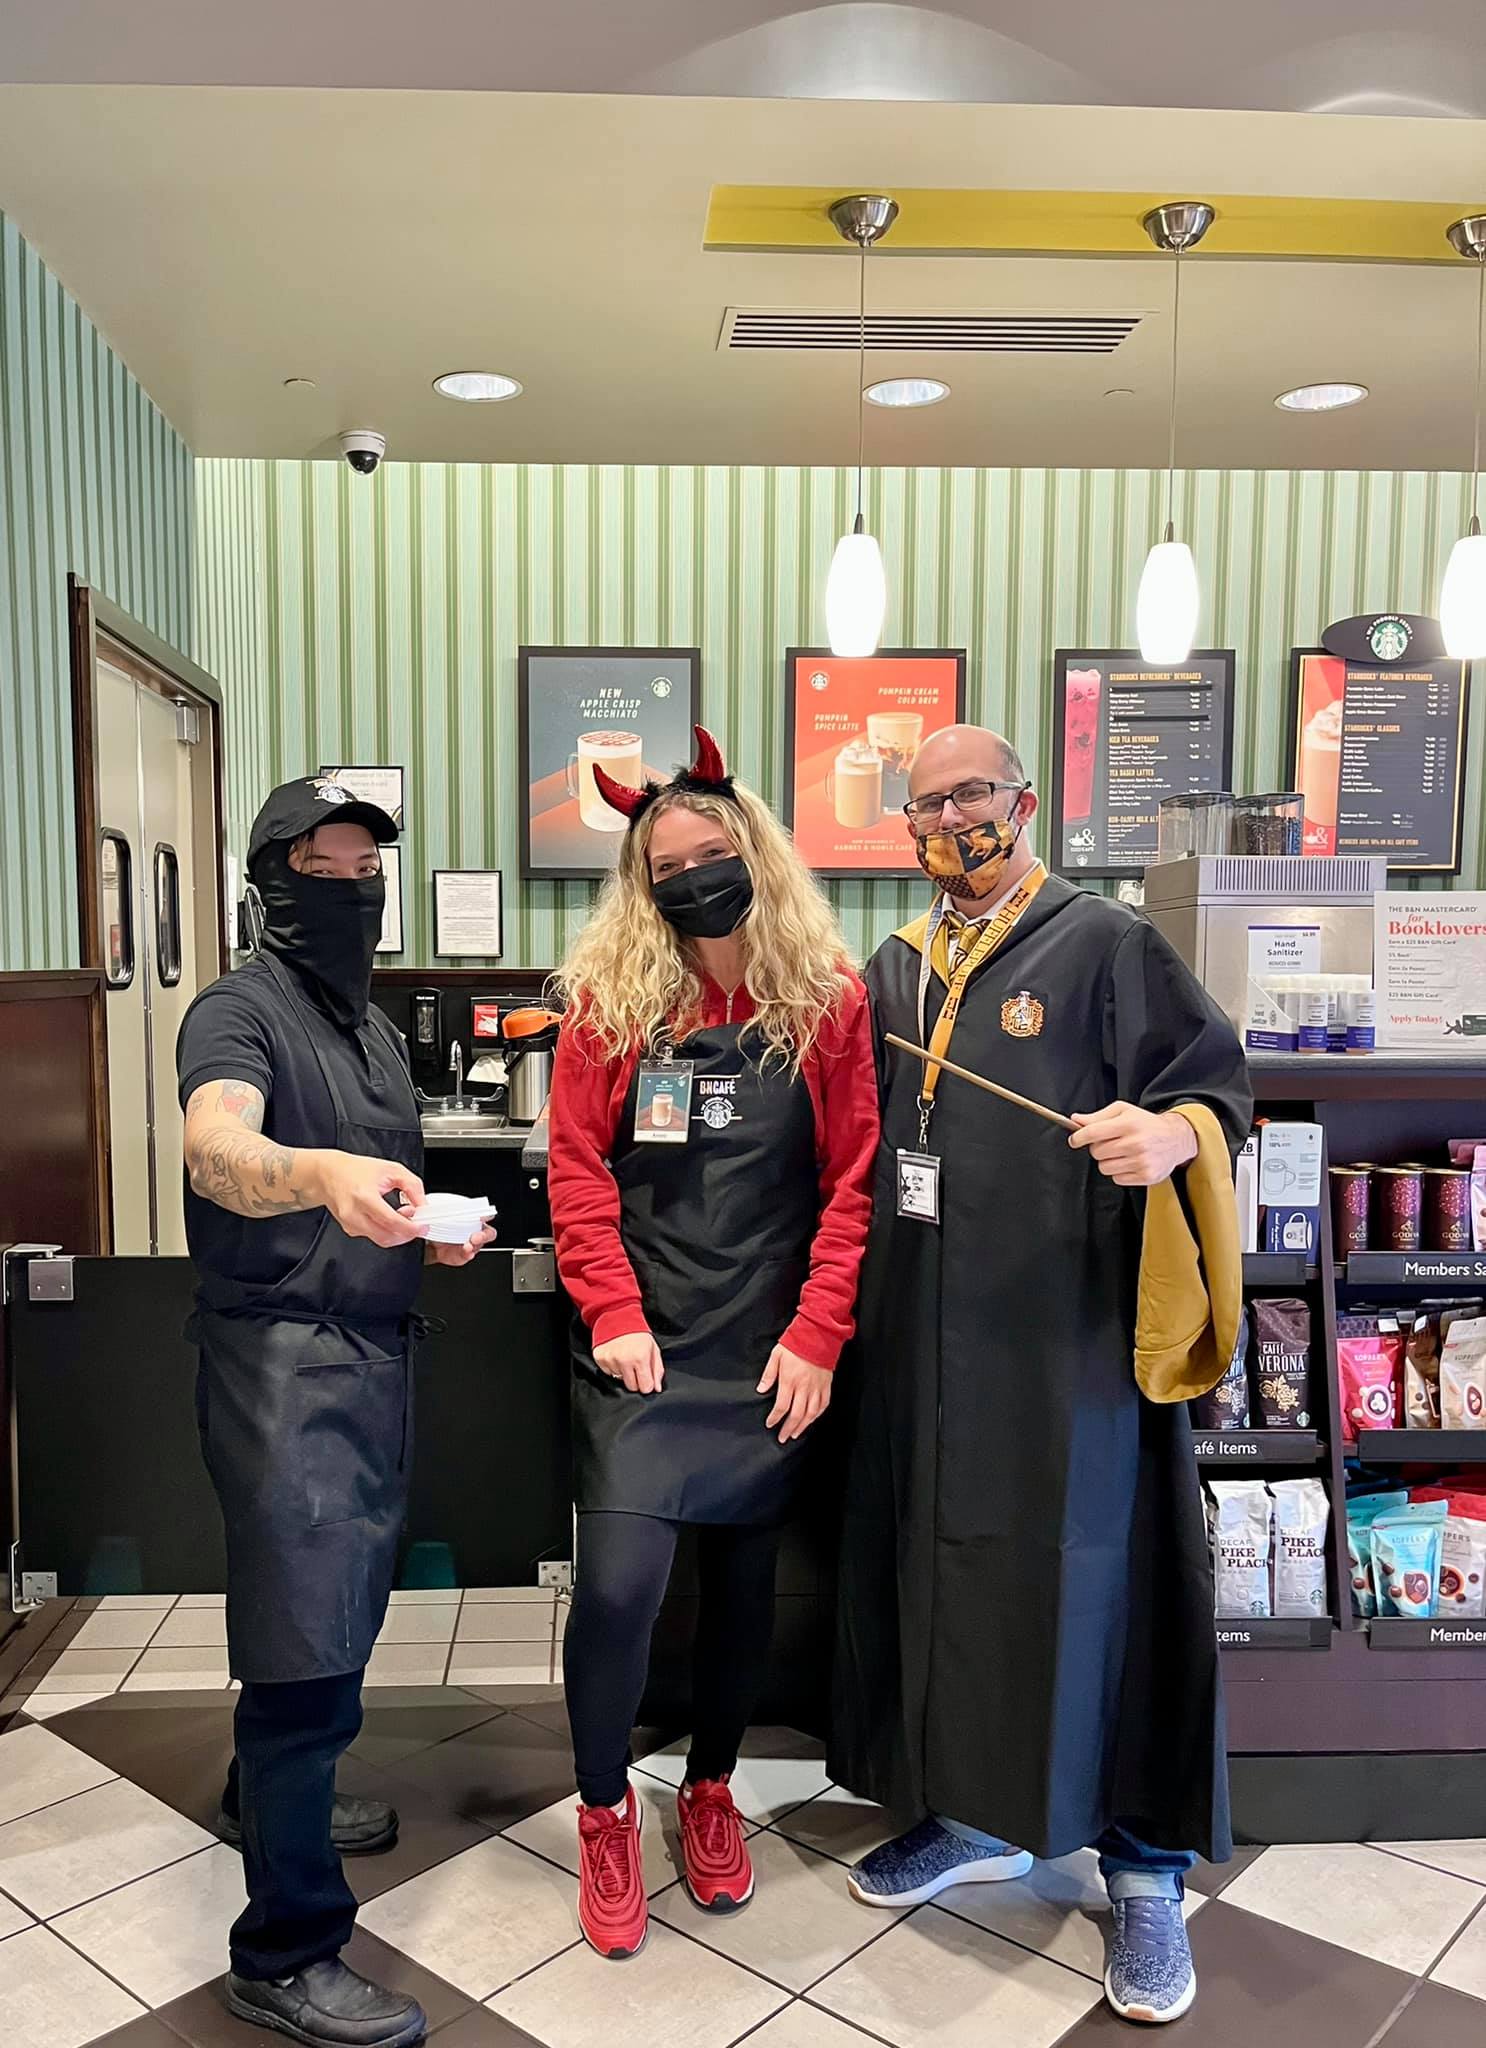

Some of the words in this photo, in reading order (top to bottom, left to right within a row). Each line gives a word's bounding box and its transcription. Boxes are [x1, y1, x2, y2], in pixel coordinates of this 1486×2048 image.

[599, 688, 622, 699] NEW
[579, 699, 609, 709] APPLE
[612, 699, 641, 709] CRISP
[897, 696, 917, 705] COLD
[918, 696, 939, 705] BREW
[583, 709, 638, 719] MACCHIATO
[814, 713, 849, 722] PUMPKIN
[815, 722, 836, 731] SPICE
[838, 723, 859, 731] LATTE
[1406, 913, 1424, 926] for
[1274, 940, 1296, 948] Hand
[1405, 1261, 1470, 1276] Members
[1257, 1355, 1306, 1372] VERONA
[1219, 1441, 1257, 1455] Items
[1281, 1537, 1316, 1547] PIKE
[1220, 1548, 1256, 1558] PIKE
